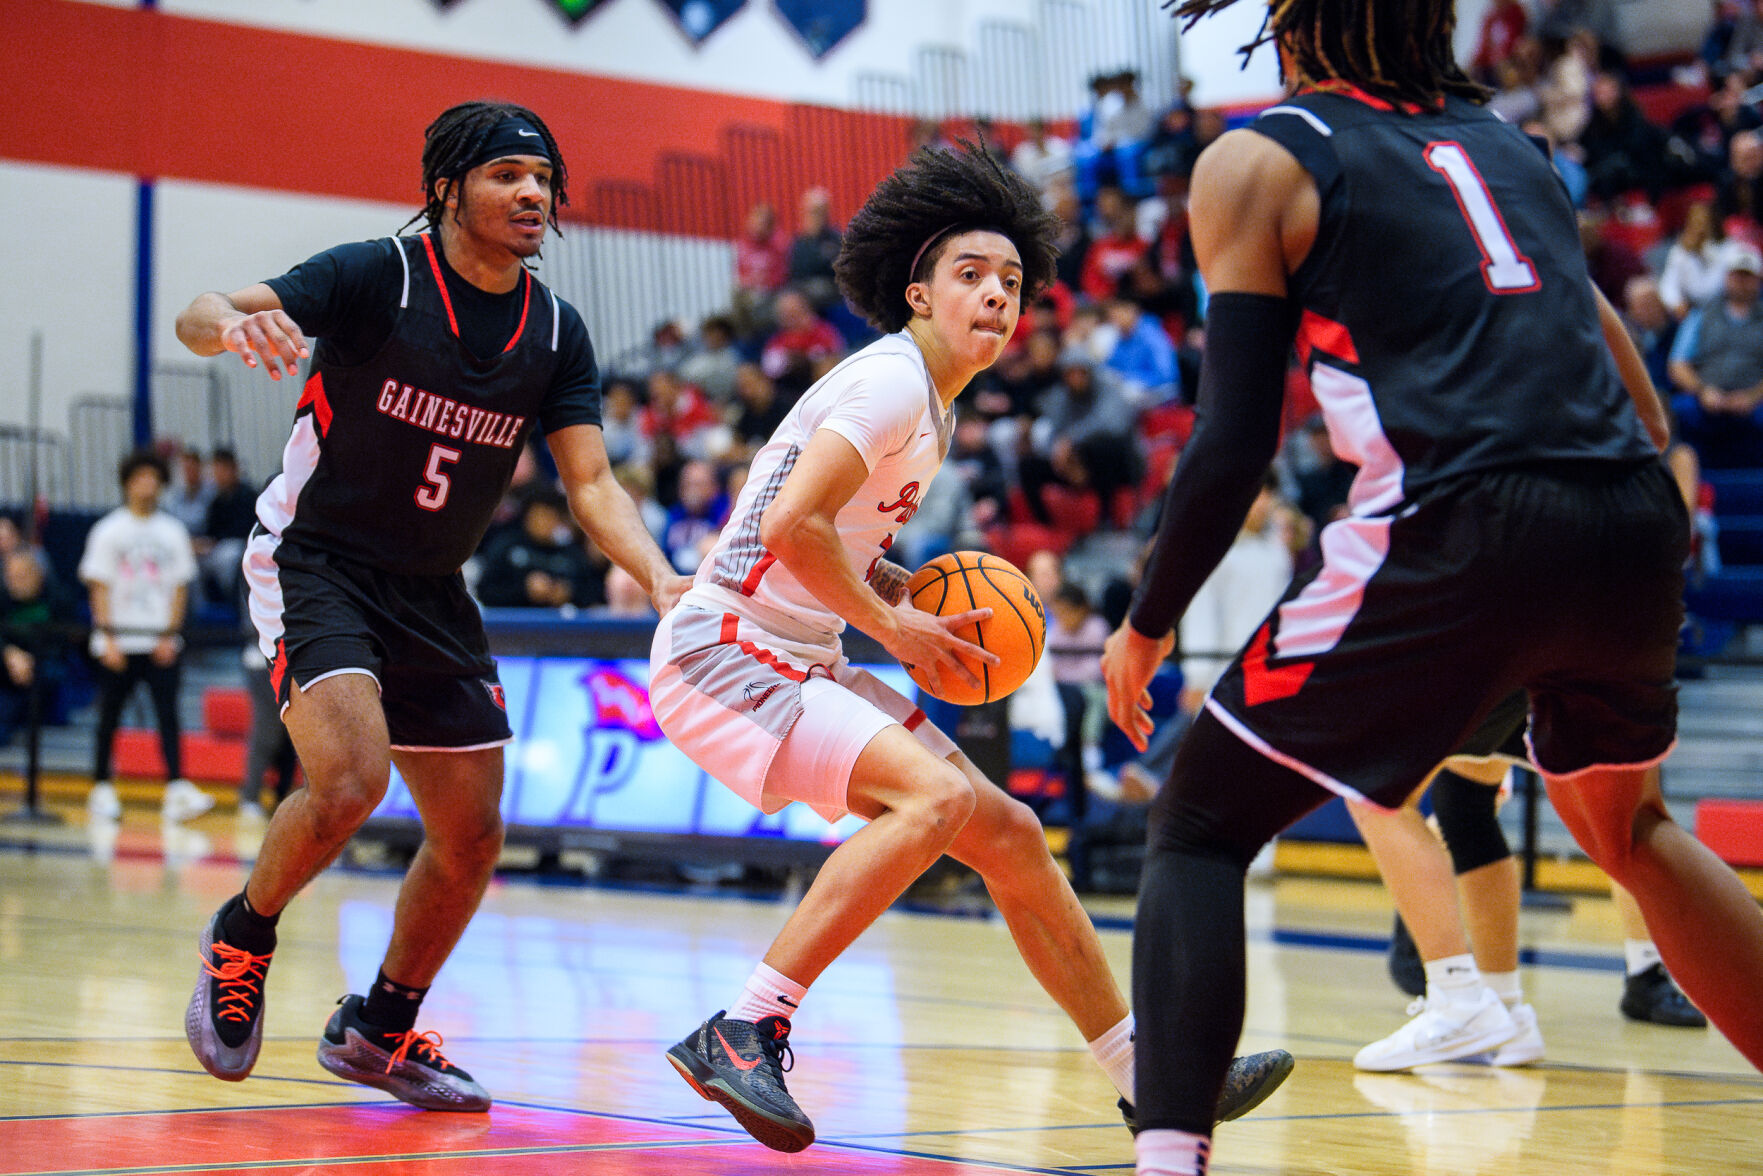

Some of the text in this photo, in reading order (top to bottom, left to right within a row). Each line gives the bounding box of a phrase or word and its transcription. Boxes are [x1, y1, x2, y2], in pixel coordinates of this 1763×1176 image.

[1422, 140, 1543, 295] 1
[376, 377, 526, 448] GAINESVILLE
[413, 442, 462, 512] 5
